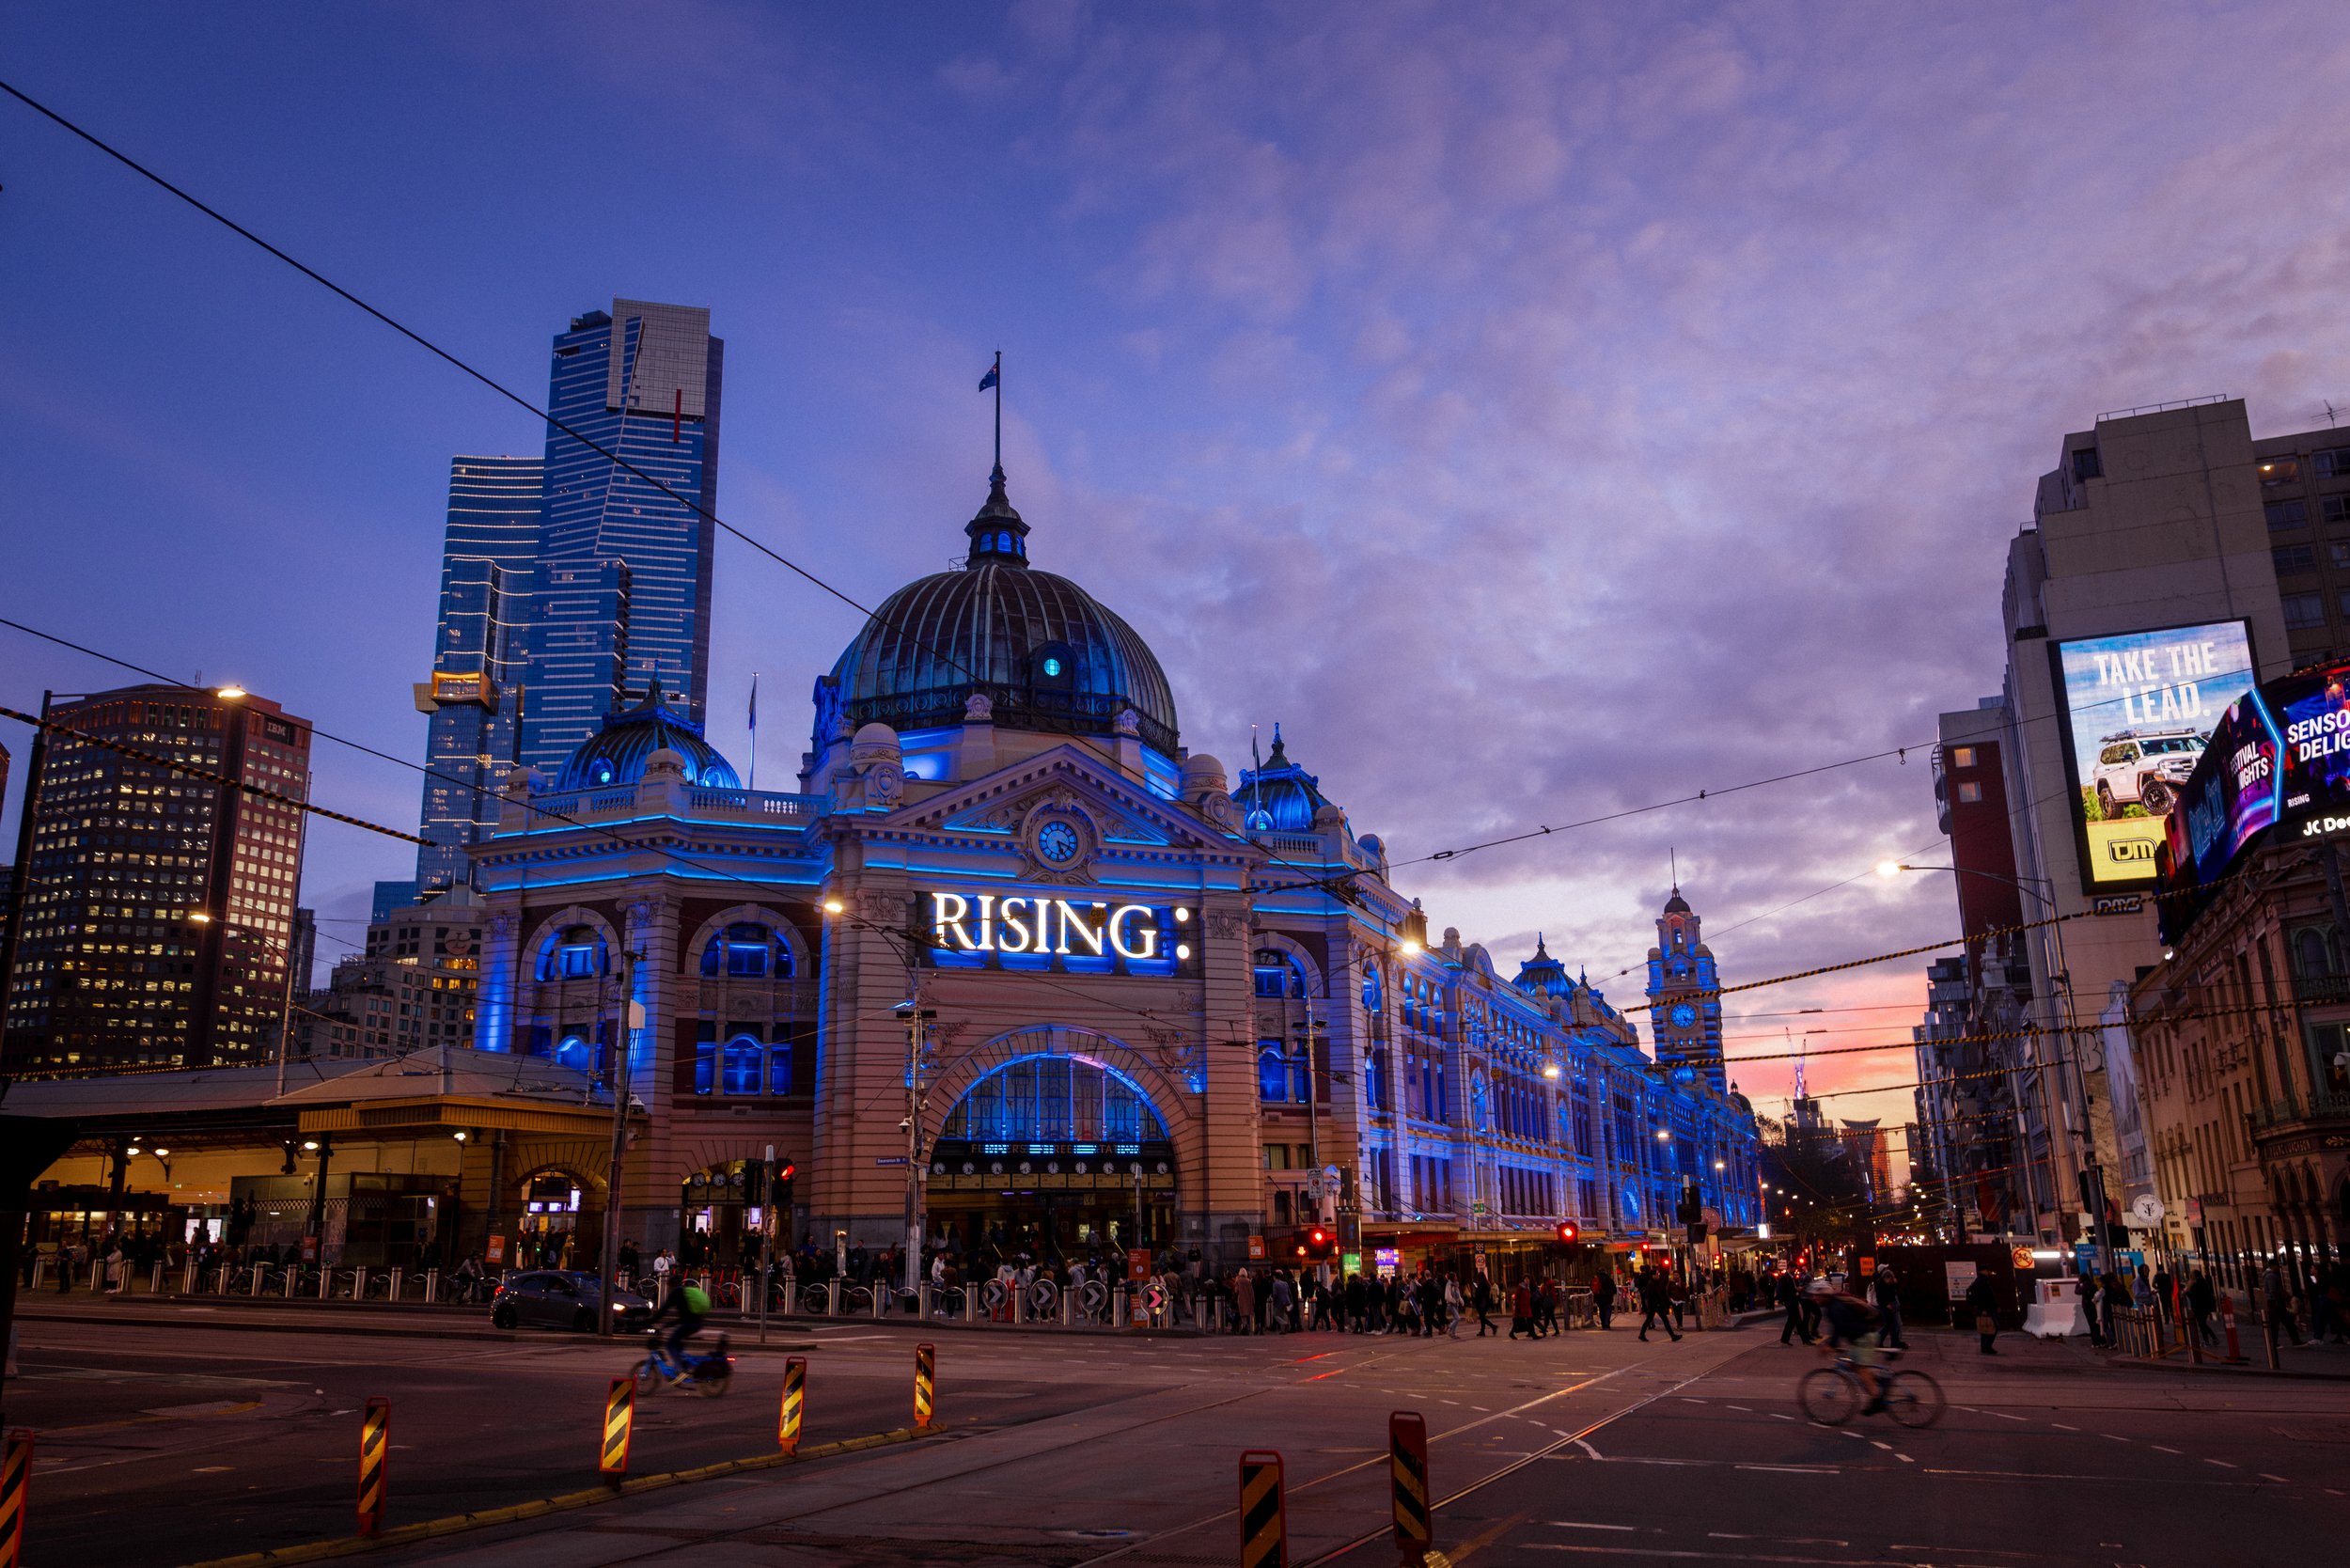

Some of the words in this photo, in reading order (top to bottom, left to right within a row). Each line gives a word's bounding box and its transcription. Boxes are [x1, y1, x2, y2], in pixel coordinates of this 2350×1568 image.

[2093, 649, 2160, 686] TAKE
[2166, 642, 2219, 677] THE
[2123, 682, 2212, 726] LEAD.
[266, 721, 287, 737] IBM
[2287, 793, 2311, 808] RISING
